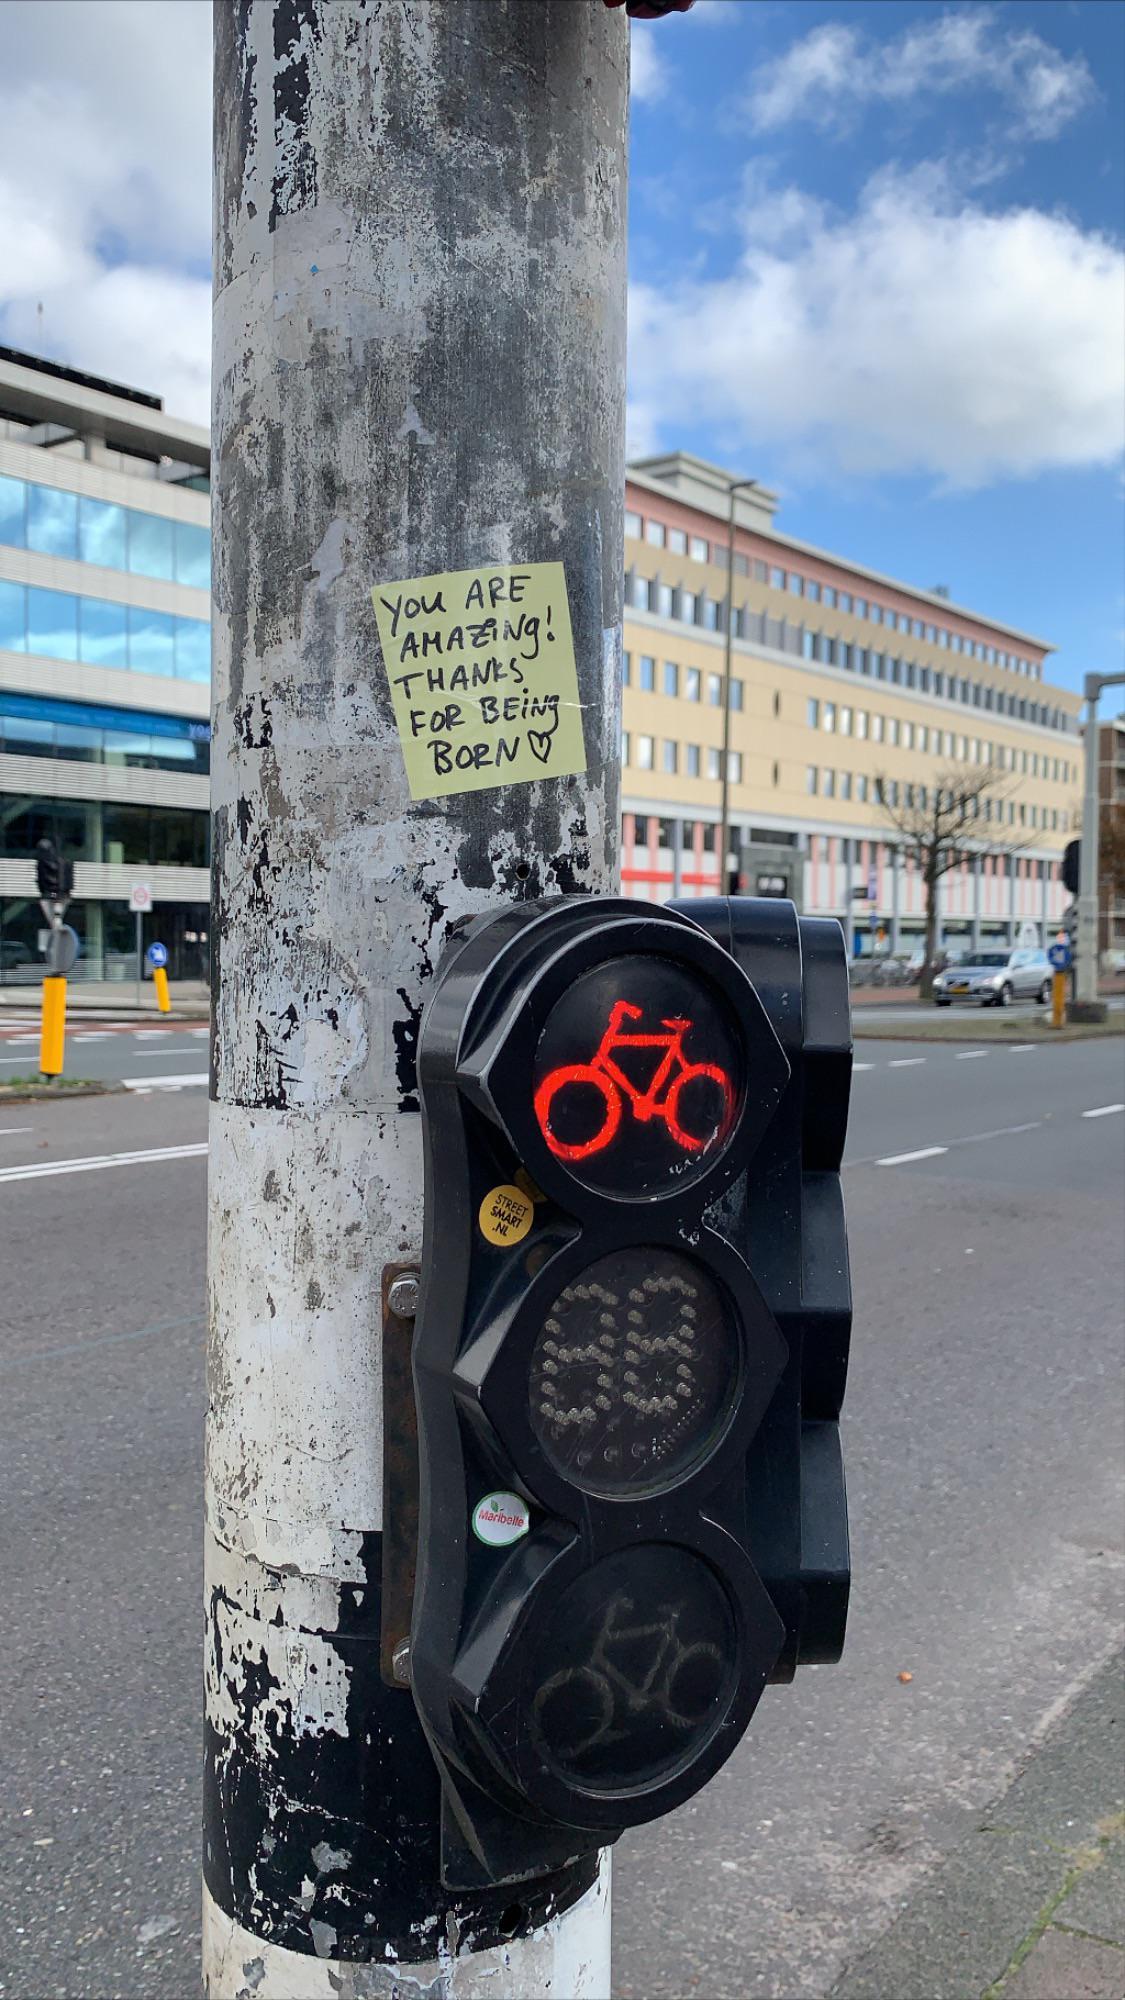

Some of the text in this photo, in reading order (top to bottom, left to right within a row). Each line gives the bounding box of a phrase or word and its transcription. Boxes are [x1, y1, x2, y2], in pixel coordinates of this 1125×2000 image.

[380, 575, 531, 637] YOU ARE
[393, 656, 524, 700] THANKS
[410, 704, 465, 737] FOR
[427, 736, 520, 776] BORN
[490, 1205, 522, 1229] SMART
[495, 1193, 528, 1217] STREET
[492, 1221, 509, 1237] .NL
[478, 1509, 525, 1527] Maribelle
